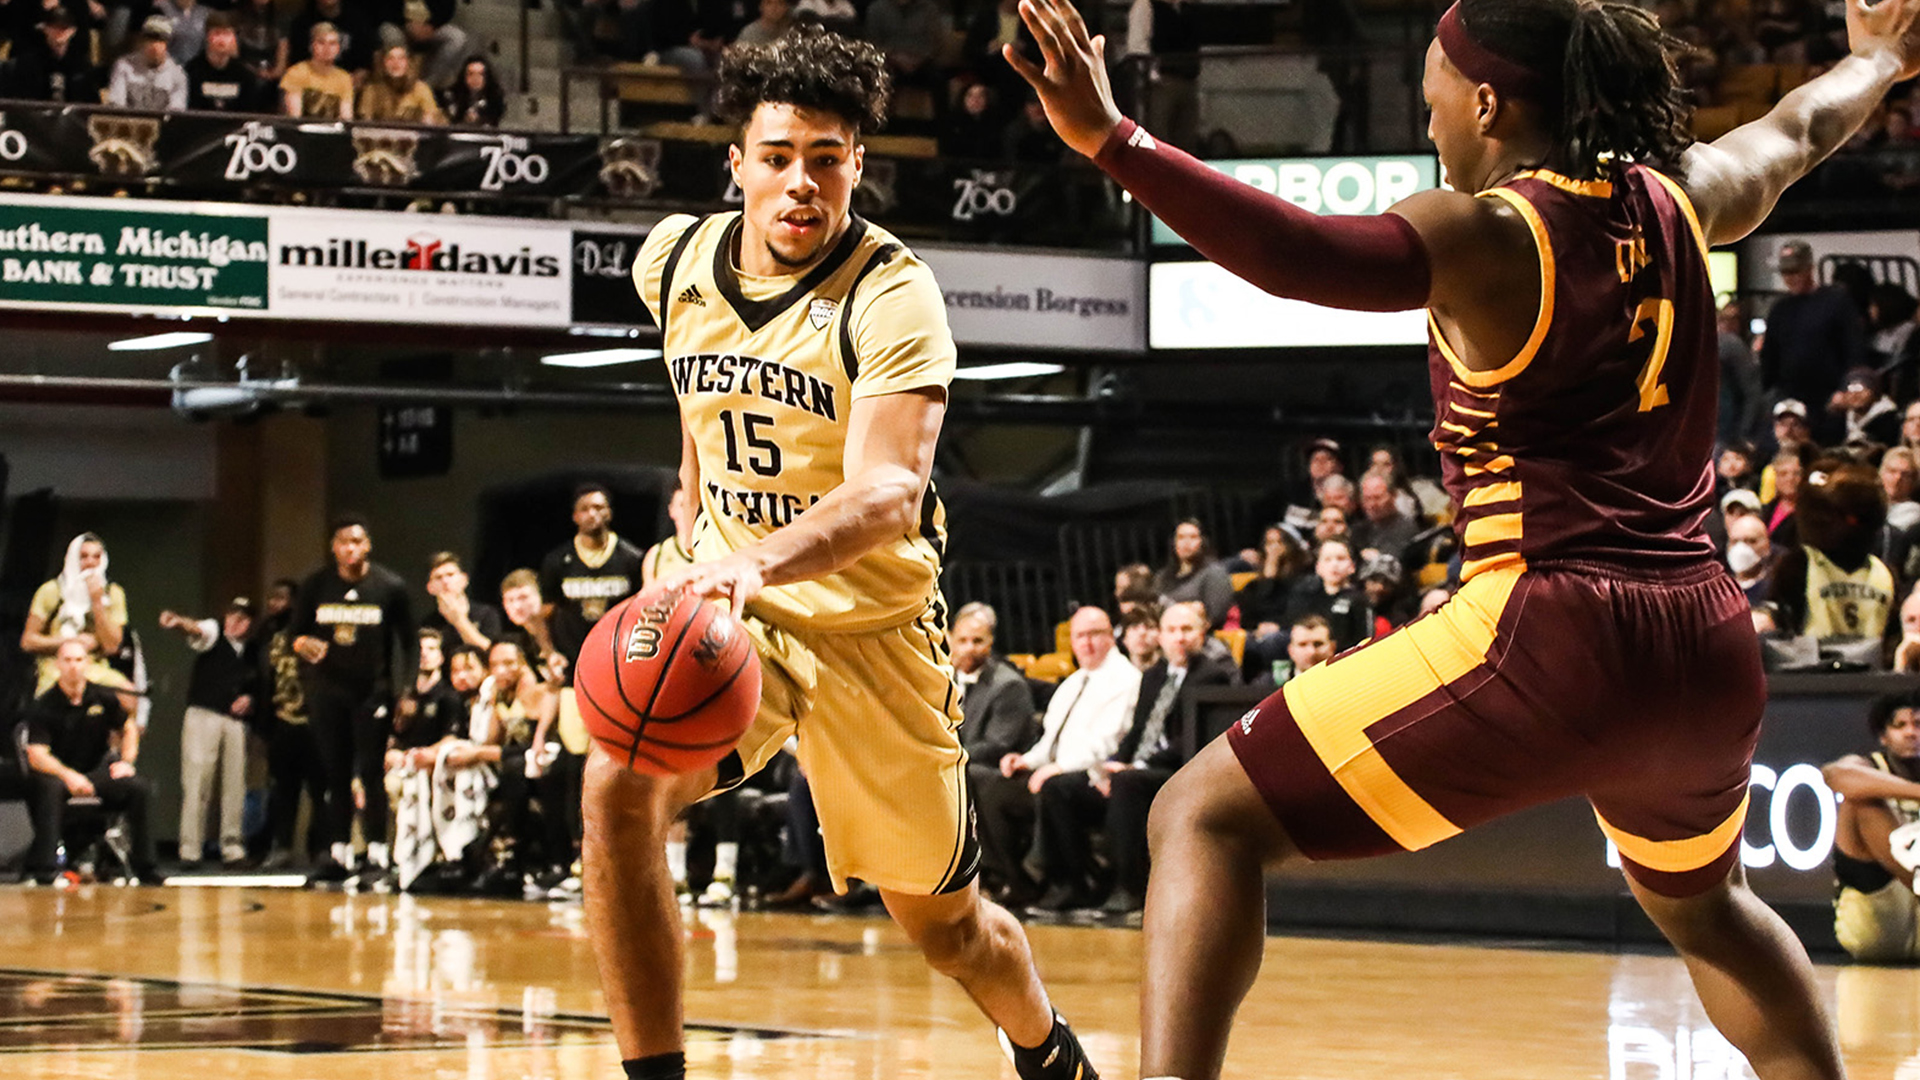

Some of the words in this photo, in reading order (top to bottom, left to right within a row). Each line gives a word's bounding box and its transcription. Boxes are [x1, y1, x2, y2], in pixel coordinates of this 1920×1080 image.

[116, 226, 268, 267] Michigan
[3, 259, 84, 286] BANK
[90, 262, 114, 287] &
[119, 264, 219, 291] TRUST
[1036, 287, 1128, 317] Borgess
[1628, 298, 1675, 412] 2
[671, 354, 837, 423] WESTERN
[719, 409, 782, 477] 15
